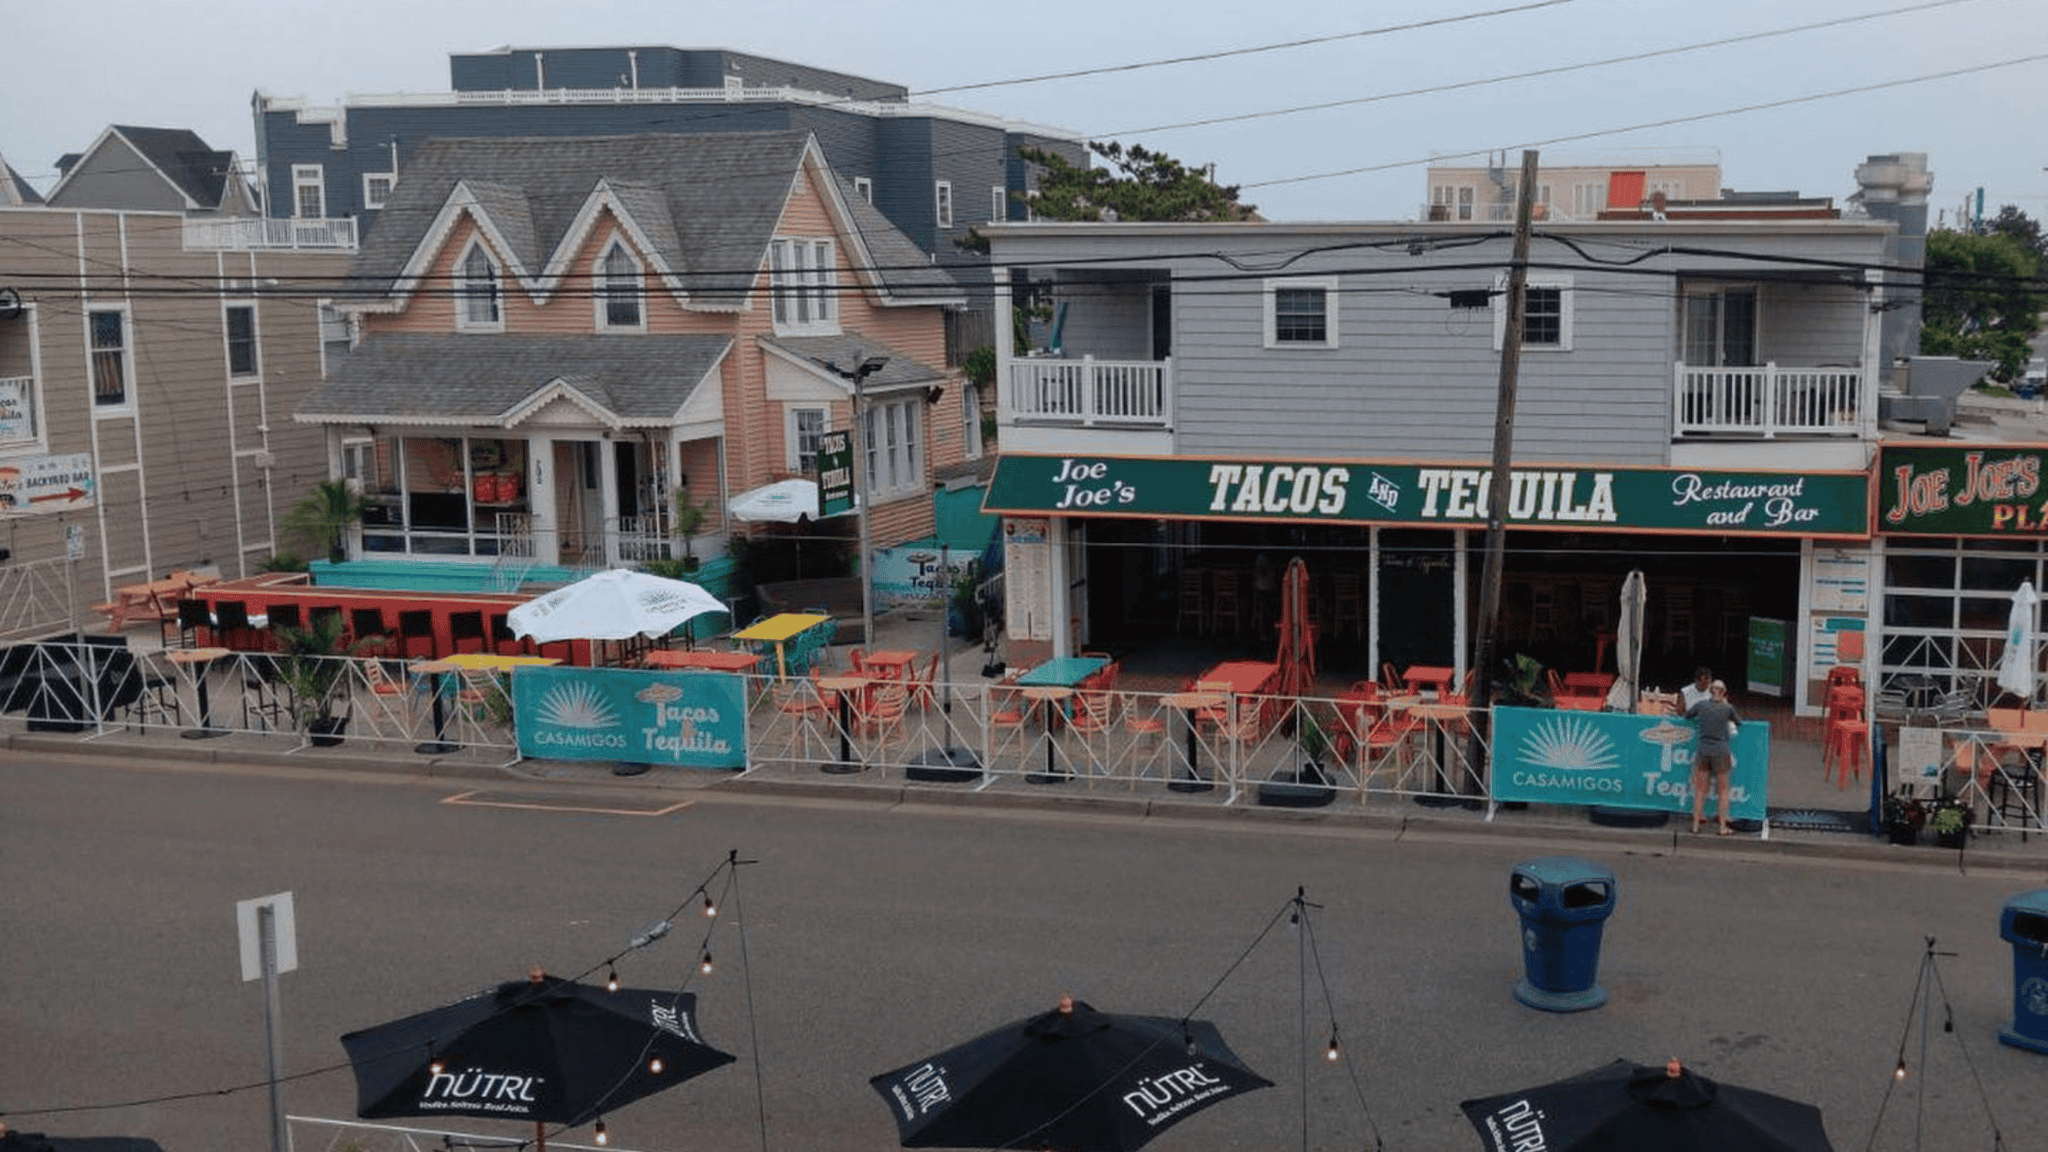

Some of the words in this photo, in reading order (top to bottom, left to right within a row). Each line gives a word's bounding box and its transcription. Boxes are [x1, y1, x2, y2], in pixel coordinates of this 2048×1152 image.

[1052, 459, 1108, 483] Joe
[1055, 480, 1136, 509] Joe's
[1209, 464, 1350, 514] TACOS
[1369, 477, 1399, 507] AND
[1672, 473, 1805, 505] Restaurant
[1706, 502, 1755, 525] and
[1764, 497, 1820, 527] Bar
[655, 701, 720, 727] Tacos
[534, 731, 627, 748] CASAMIGOS
[642, 728, 731, 760] Tequila
[1513, 771, 1623, 792] CASAMIGOS
